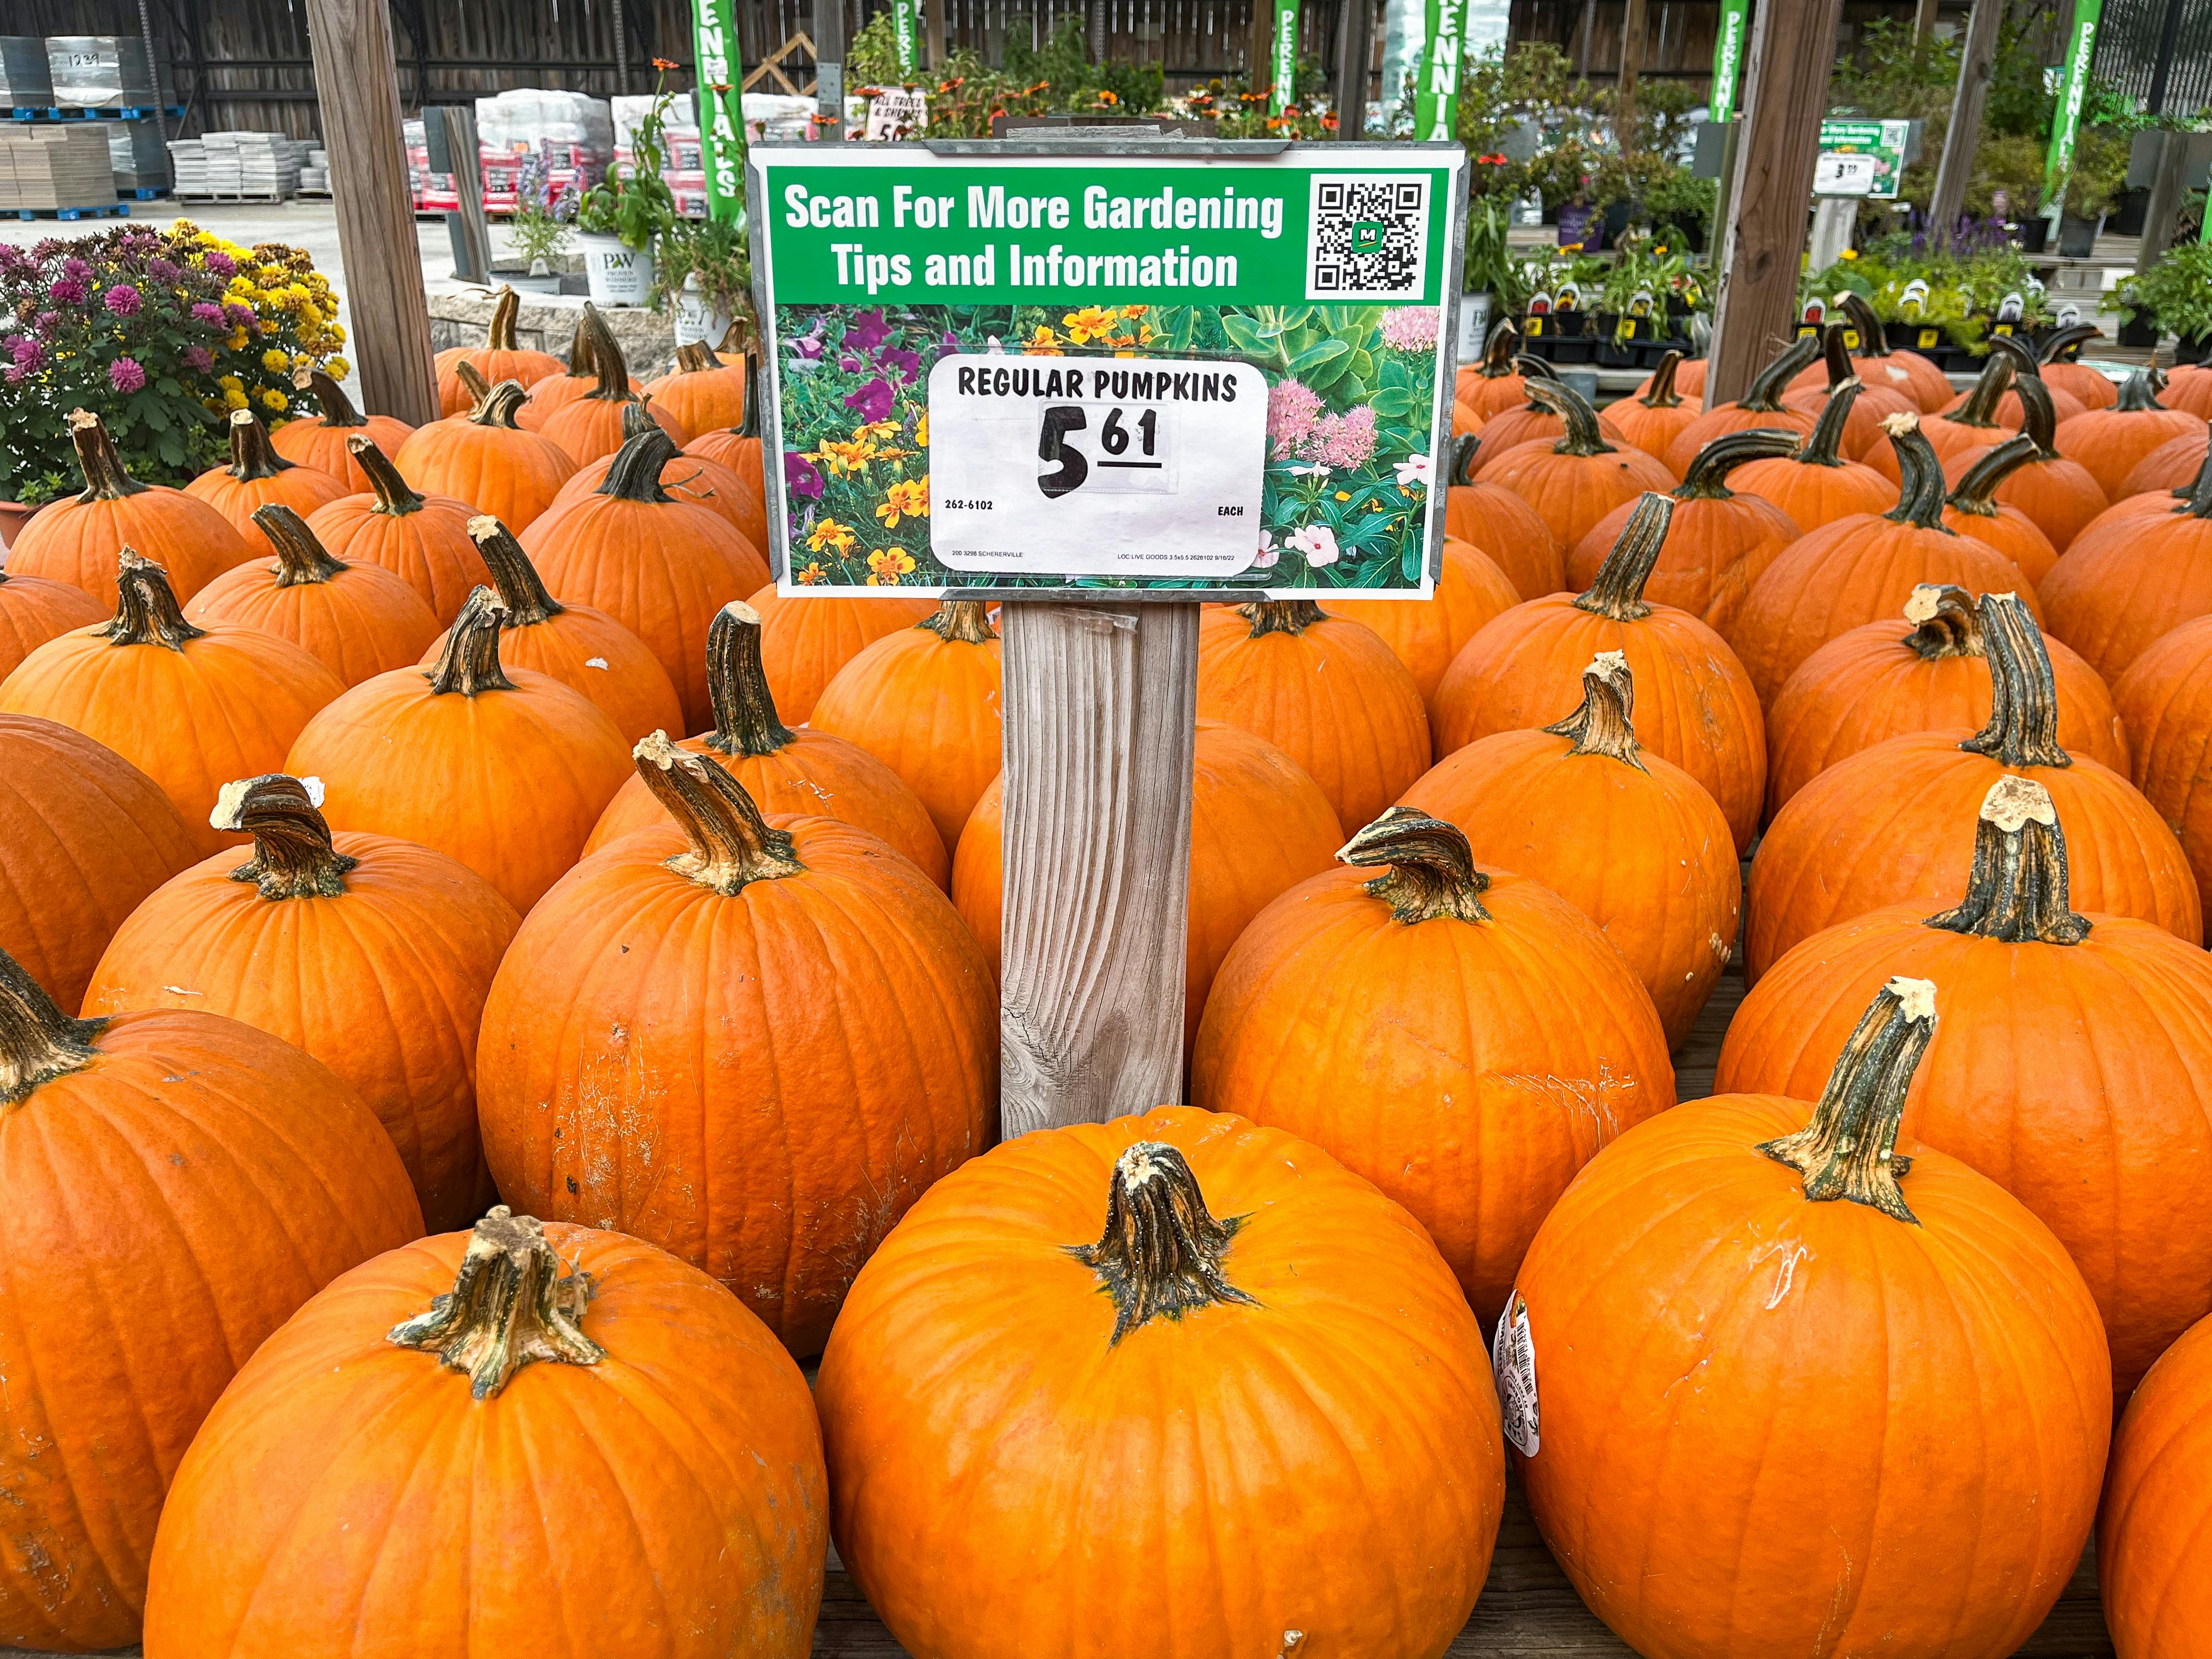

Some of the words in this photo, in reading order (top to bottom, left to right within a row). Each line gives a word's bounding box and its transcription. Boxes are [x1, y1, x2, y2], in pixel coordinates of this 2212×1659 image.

[784, 184, 879, 229] Scan
[893, 185, 955, 229] For
[967, 185, 1070, 229] More
[1084, 185, 1284, 239] Gardening
[831, 243, 913, 295] Tips
[924, 244, 996, 287] and
[1010, 244, 1237, 288] Information
[958, 366, 1084, 398] REGULAR
[1094, 370, 1237, 402] PUMPKINS
[945, 499, 993, 510] 262-6102
[1217, 506, 1244, 516] EACH
